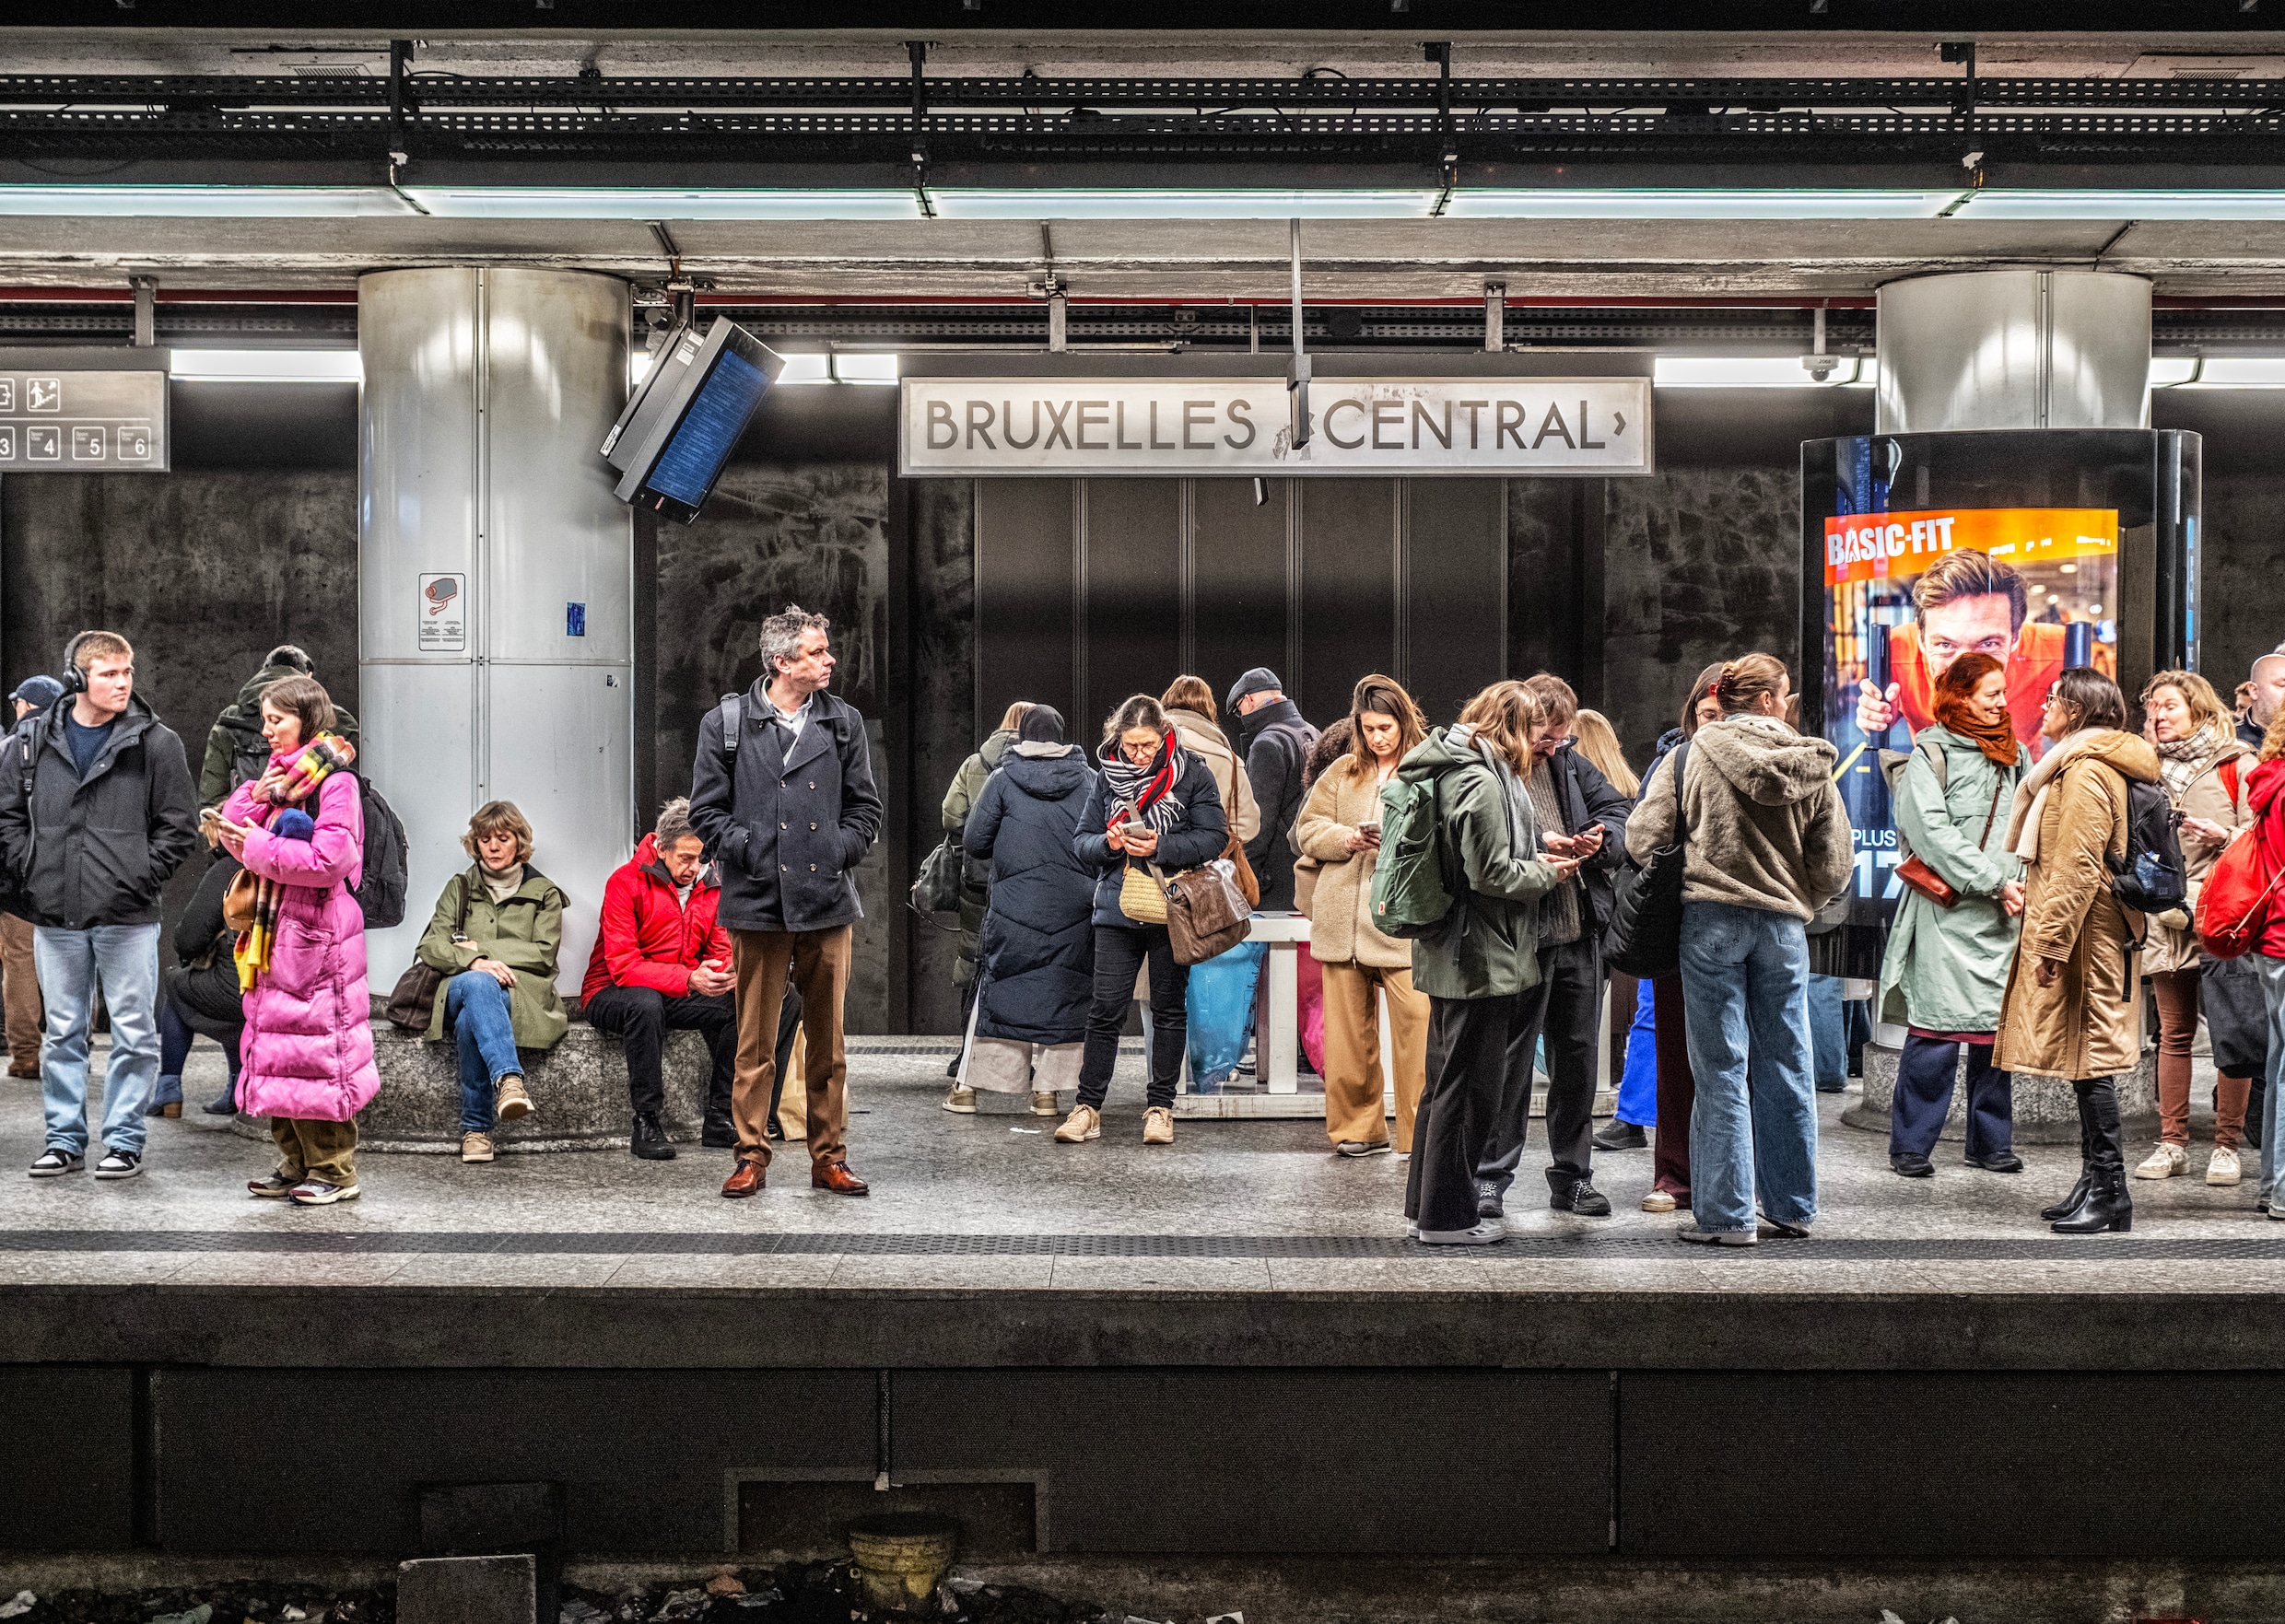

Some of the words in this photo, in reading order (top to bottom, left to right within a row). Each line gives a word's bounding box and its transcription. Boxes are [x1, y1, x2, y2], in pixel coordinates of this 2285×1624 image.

[926, 400, 1257, 451] BRUXELLES
[1323, 400, 1607, 451] CENTRAL
[44, 438, 55, 455] 4
[89, 438, 100, 455] 5
[135, 438, 146, 455] 6
[1827, 516, 1955, 567] BASIC-FIT
[1851, 828, 1897, 847] PLUS
[1853, 849, 1904, 899] 17
